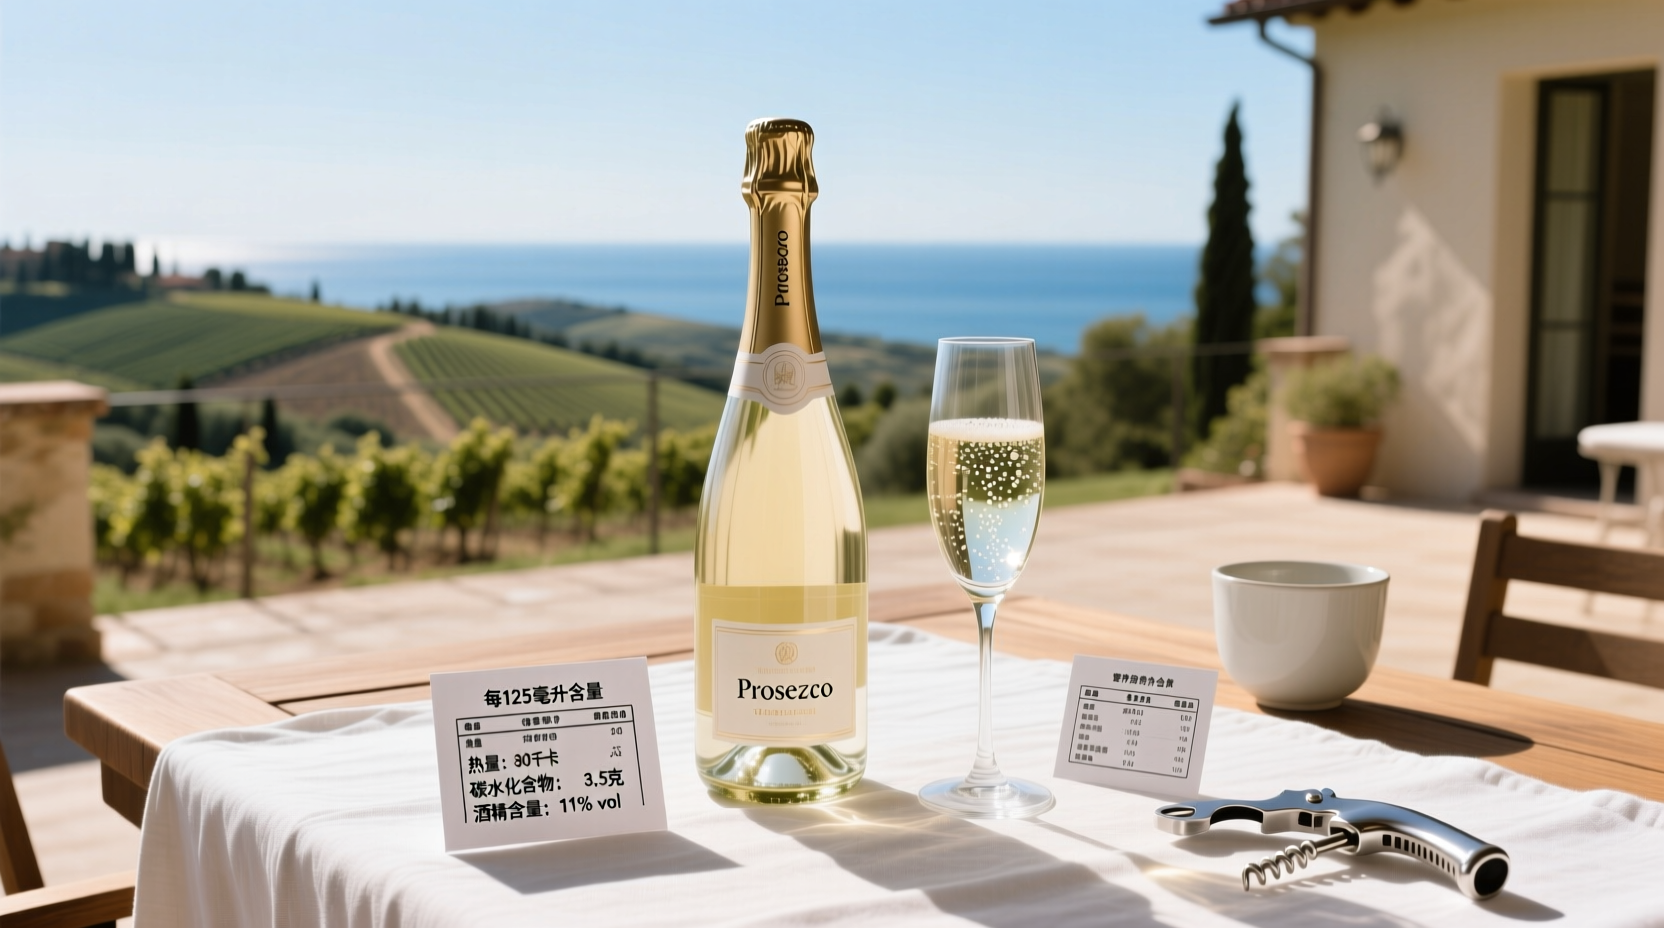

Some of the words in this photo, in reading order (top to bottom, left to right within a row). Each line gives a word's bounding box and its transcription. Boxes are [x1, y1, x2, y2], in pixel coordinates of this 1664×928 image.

[484, 682, 603, 707] 每125毫升含量
[737, 678, 833, 700] Prosezco
[597, 793, 621, 809] vol
